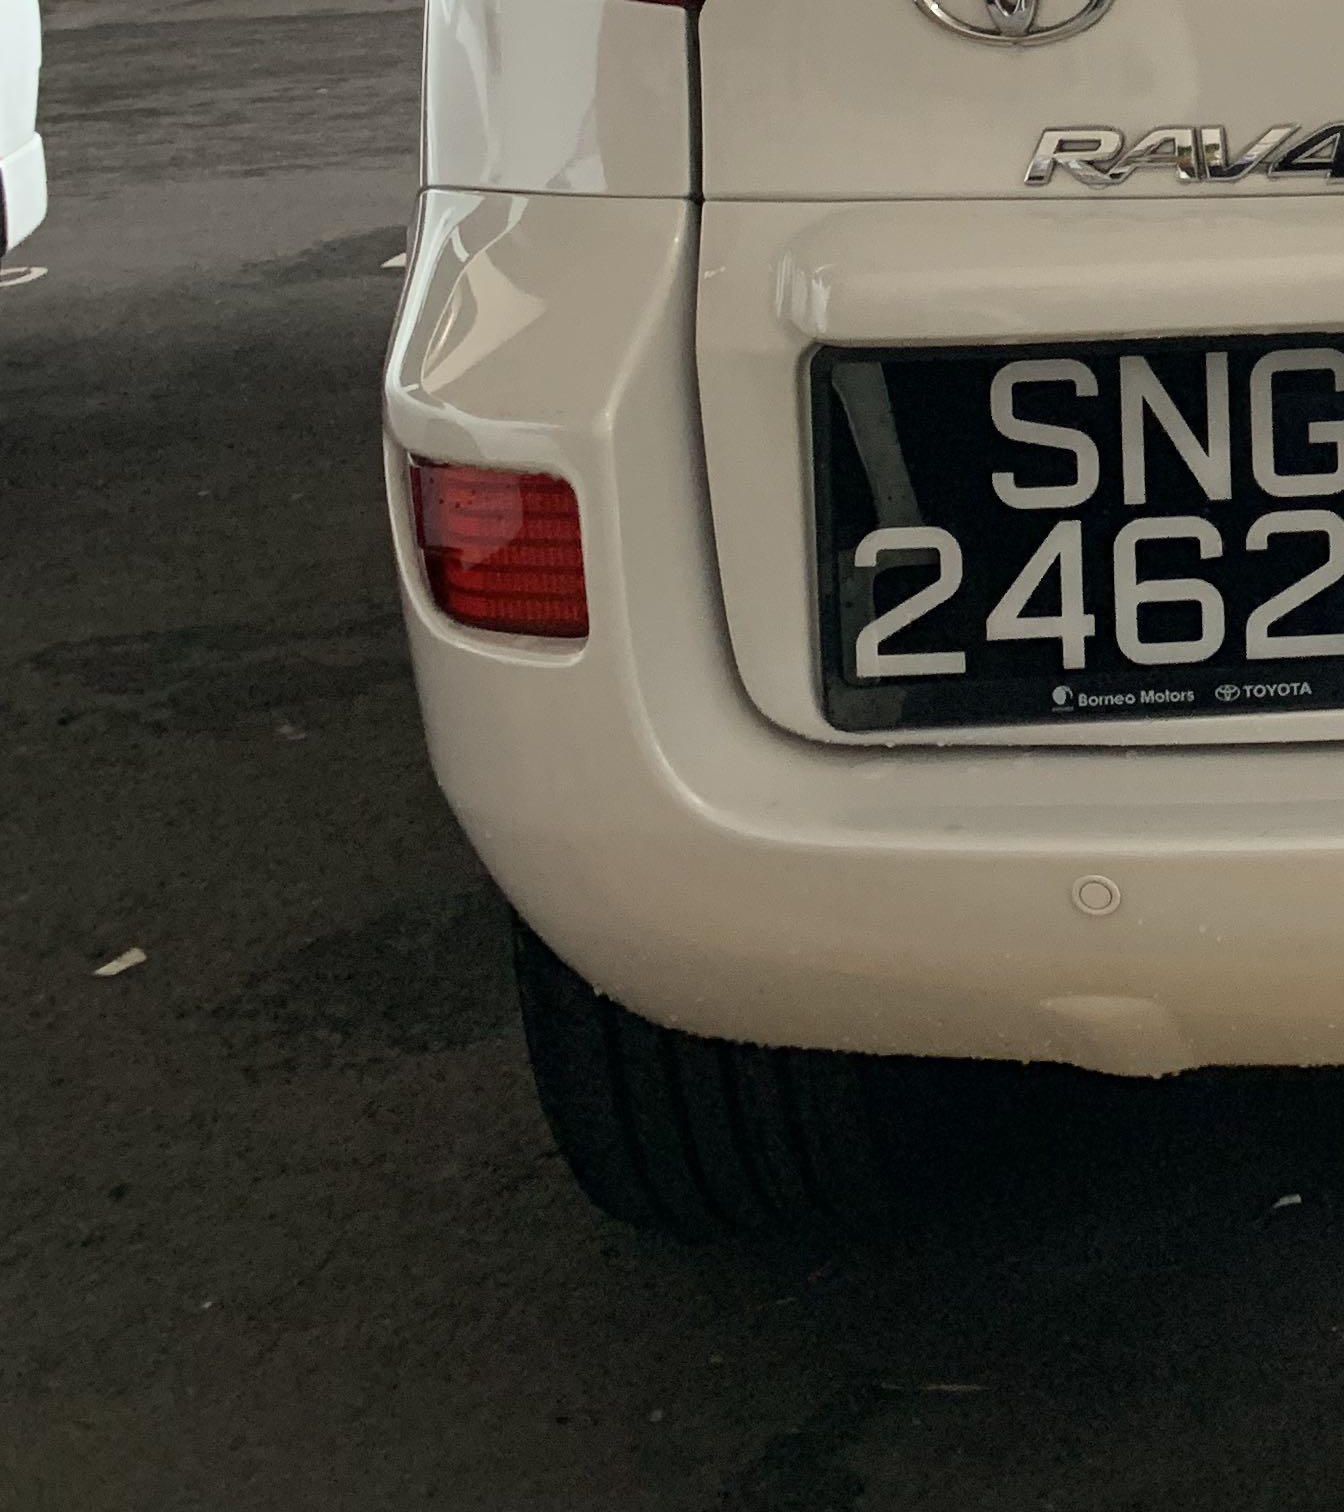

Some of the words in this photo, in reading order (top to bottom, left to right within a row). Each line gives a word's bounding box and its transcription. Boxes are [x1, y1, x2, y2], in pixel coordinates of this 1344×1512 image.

[1078, 692, 1136, 708] Borneo
[1140, 689, 1195, 705] Motors
[1242, 682, 1313, 699] TOYOTA
